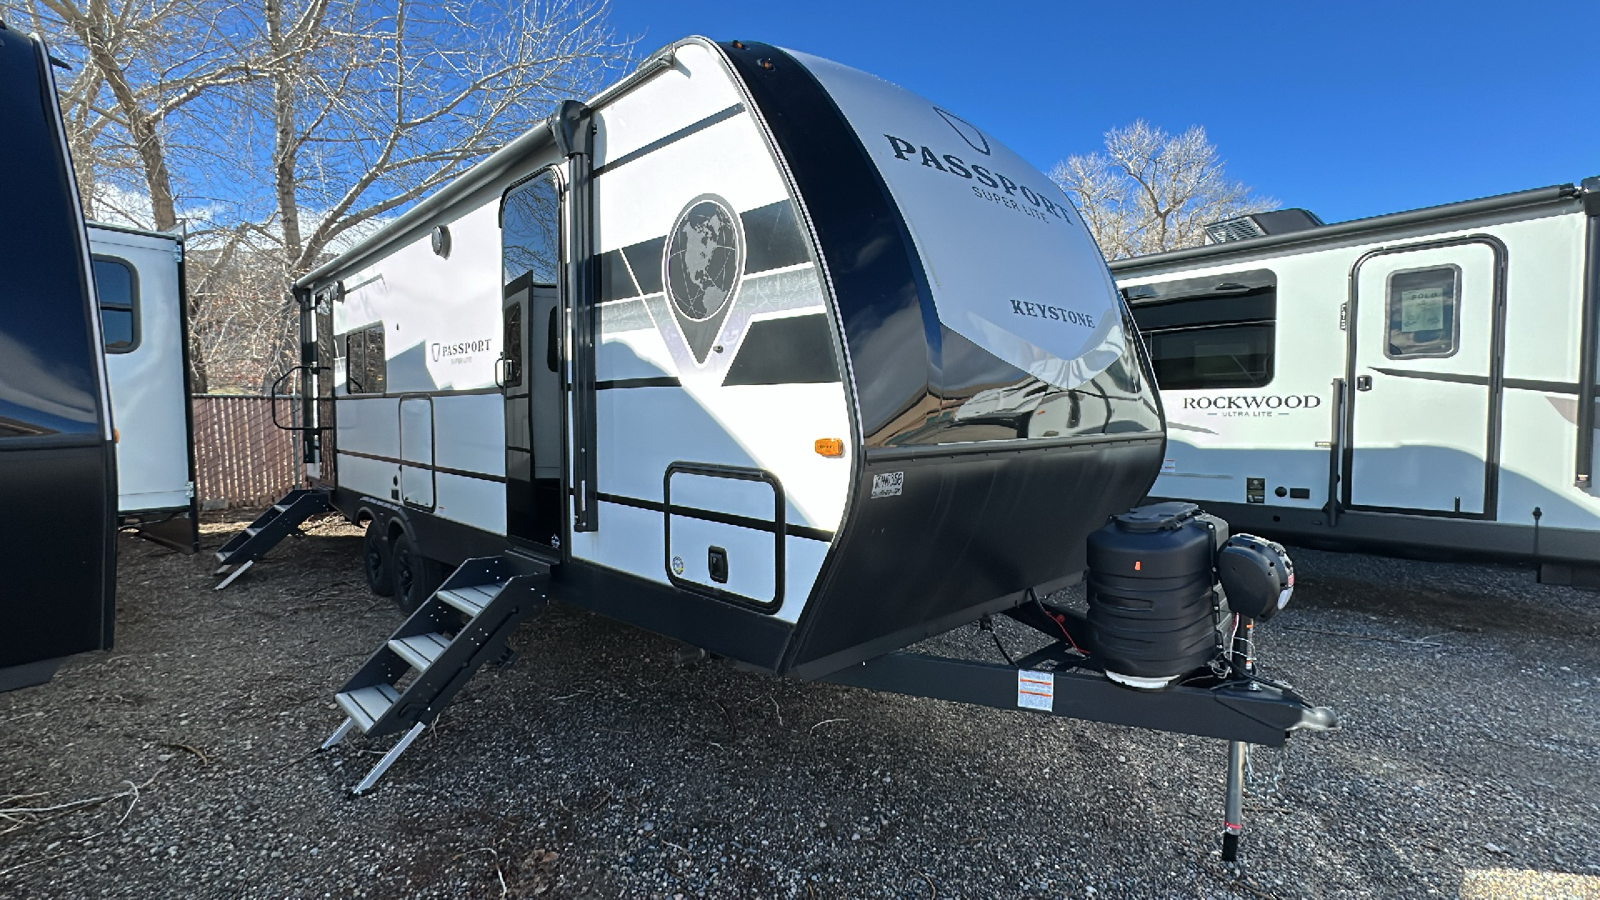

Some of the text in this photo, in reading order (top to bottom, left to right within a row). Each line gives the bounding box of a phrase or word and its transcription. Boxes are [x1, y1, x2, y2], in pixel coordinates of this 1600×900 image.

[884, 133, 1073, 226] PASSPORT
[971, 186, 1050, 224] SUPER LITE
[1009, 299, 1096, 329] KEYSTONE
[442, 338, 492, 357] PASSPORT
[1183, 395, 1321, 409] ROCKWOOD
